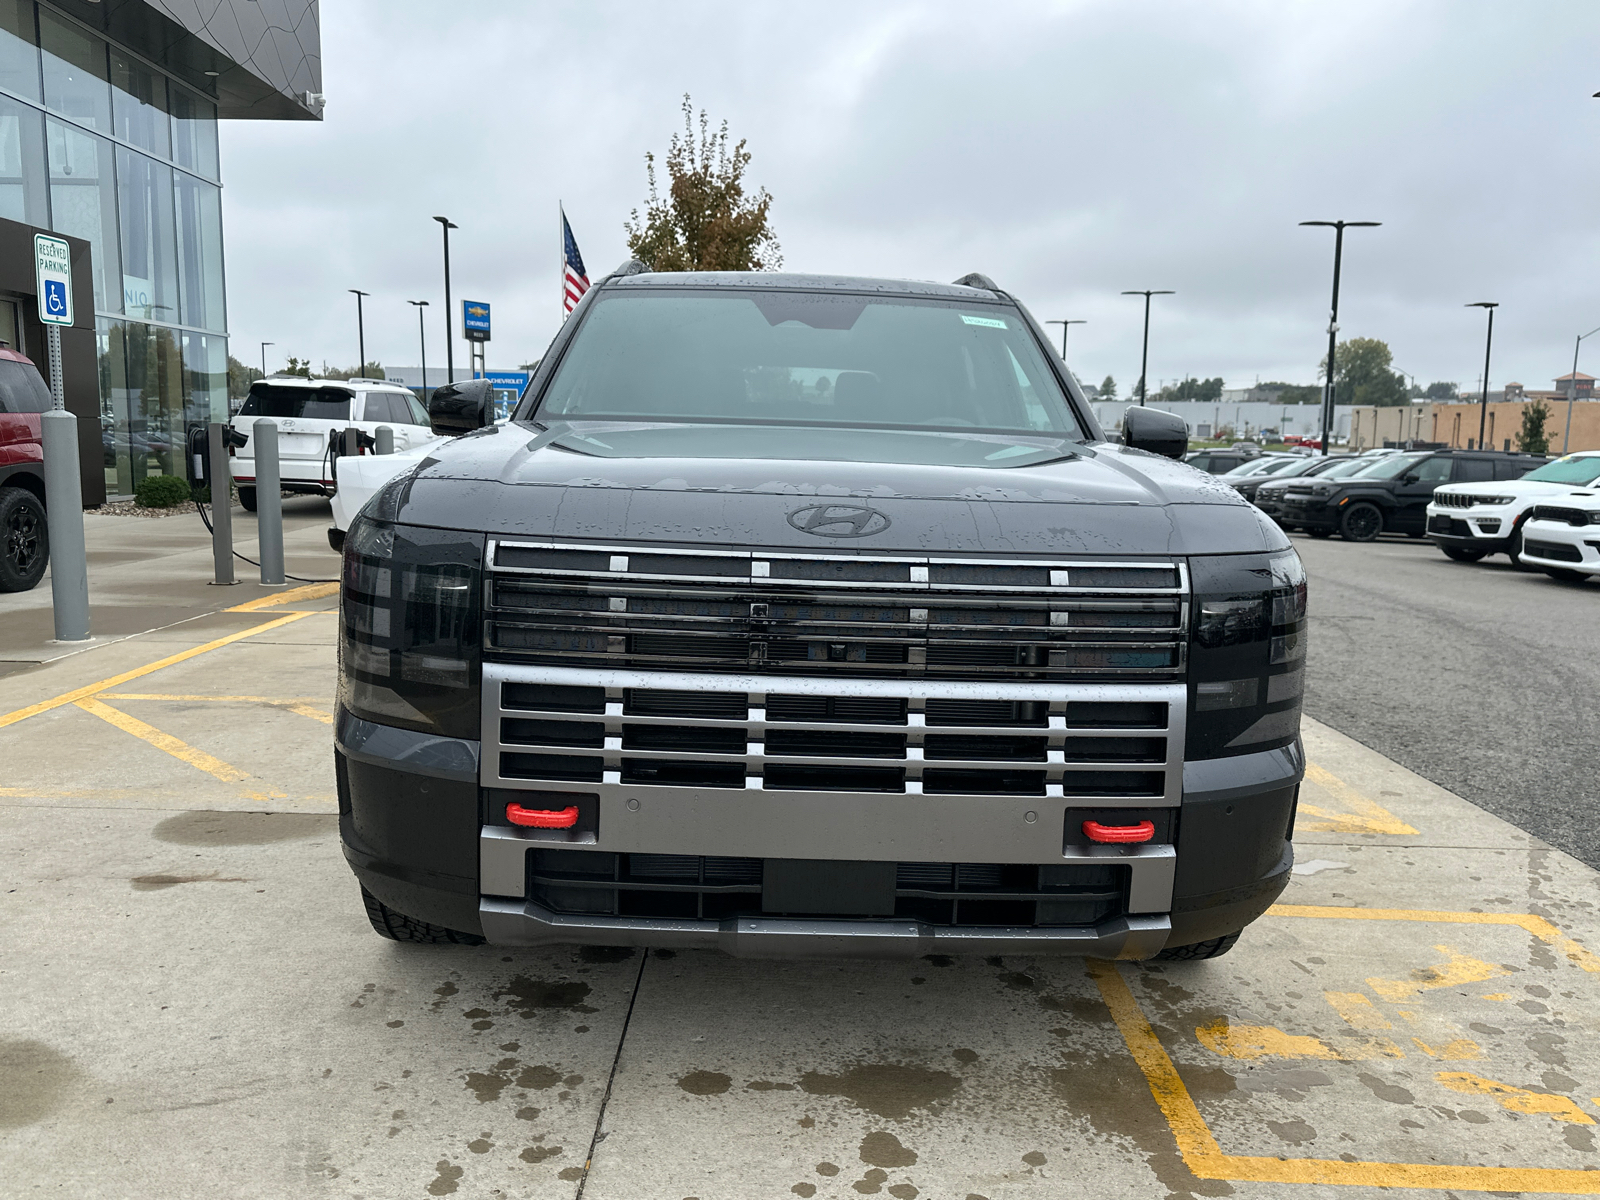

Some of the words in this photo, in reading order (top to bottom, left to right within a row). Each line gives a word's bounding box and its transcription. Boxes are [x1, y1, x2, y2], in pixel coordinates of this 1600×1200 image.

[39, 244, 66, 260] RESERVED
[40, 259, 68, 274] PARKING
[466, 320, 489, 328] CHEVROLET
